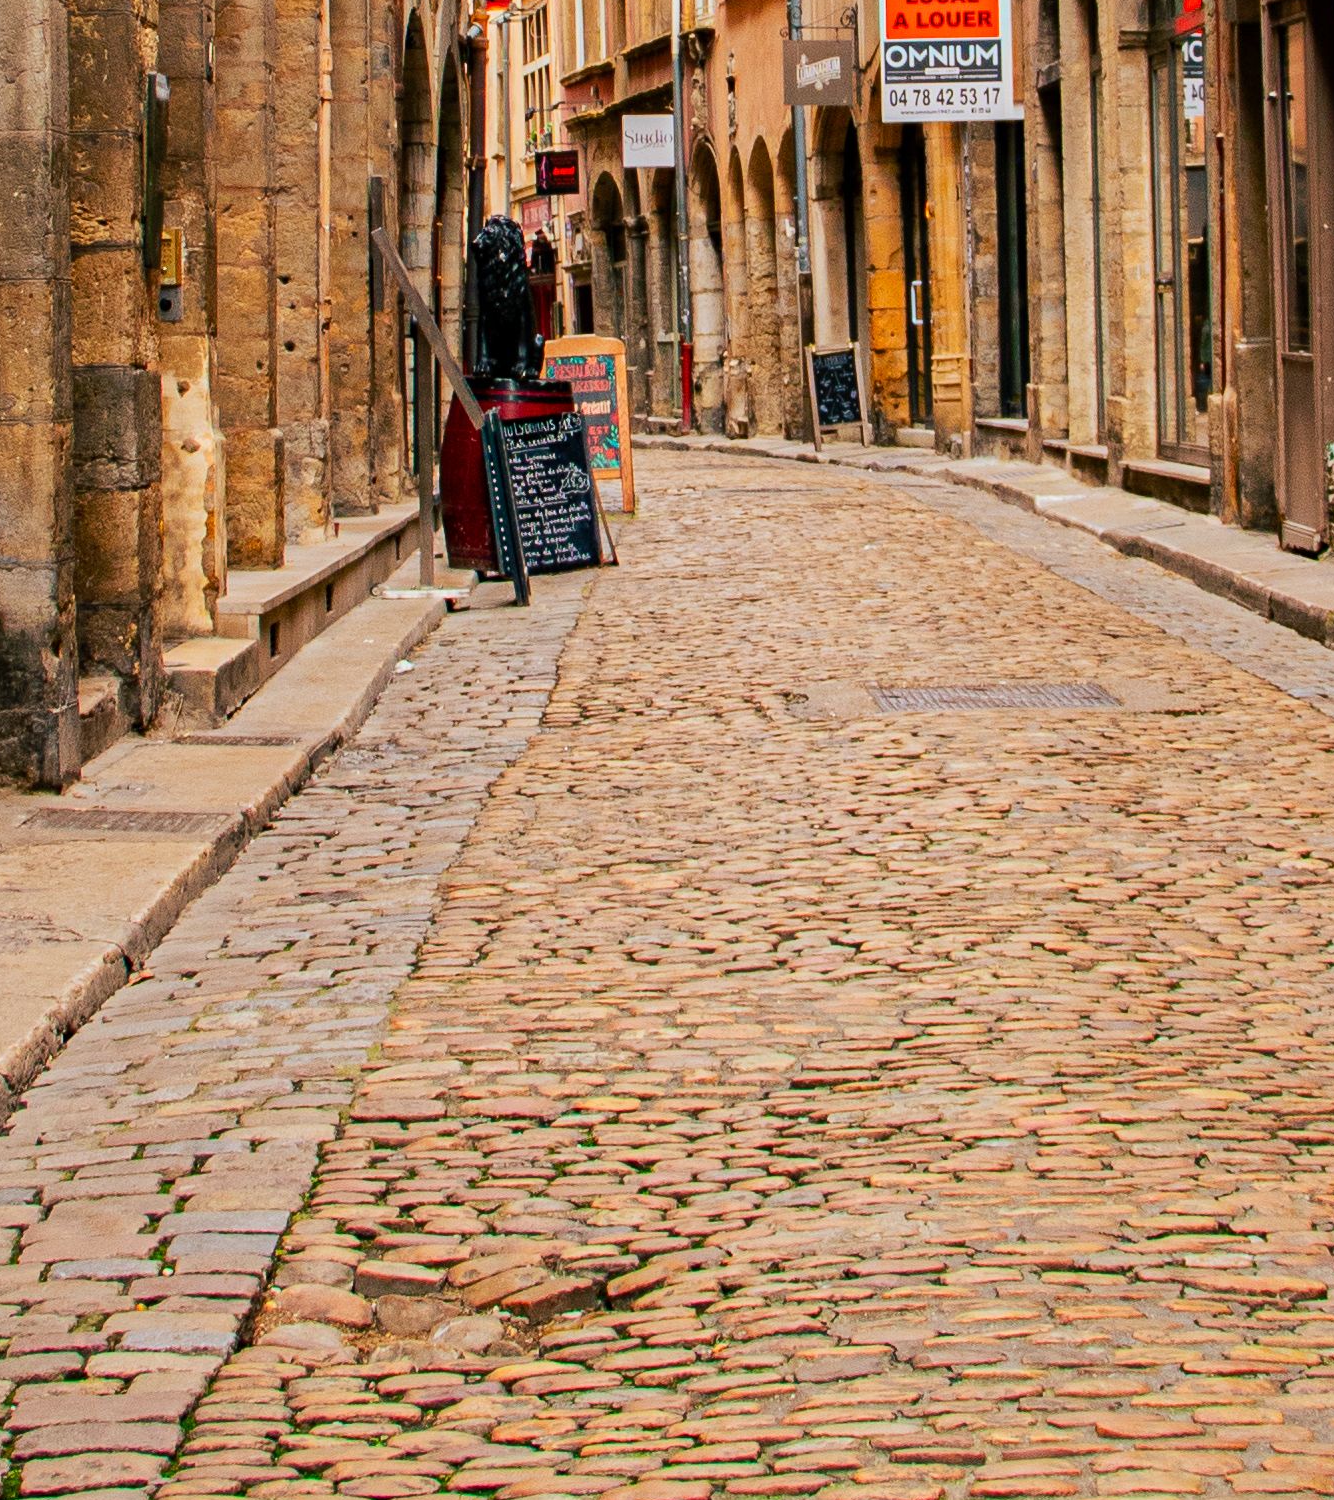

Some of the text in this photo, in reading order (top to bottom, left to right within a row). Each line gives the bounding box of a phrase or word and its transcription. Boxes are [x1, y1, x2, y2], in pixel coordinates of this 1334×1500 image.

[892, 10, 993, 29] A LOUER
[885, 43, 999, 68] OMNIUM
[889, 87, 1000, 107] 04 78 42 53 17
[624, 129, 673, 145] Studio
